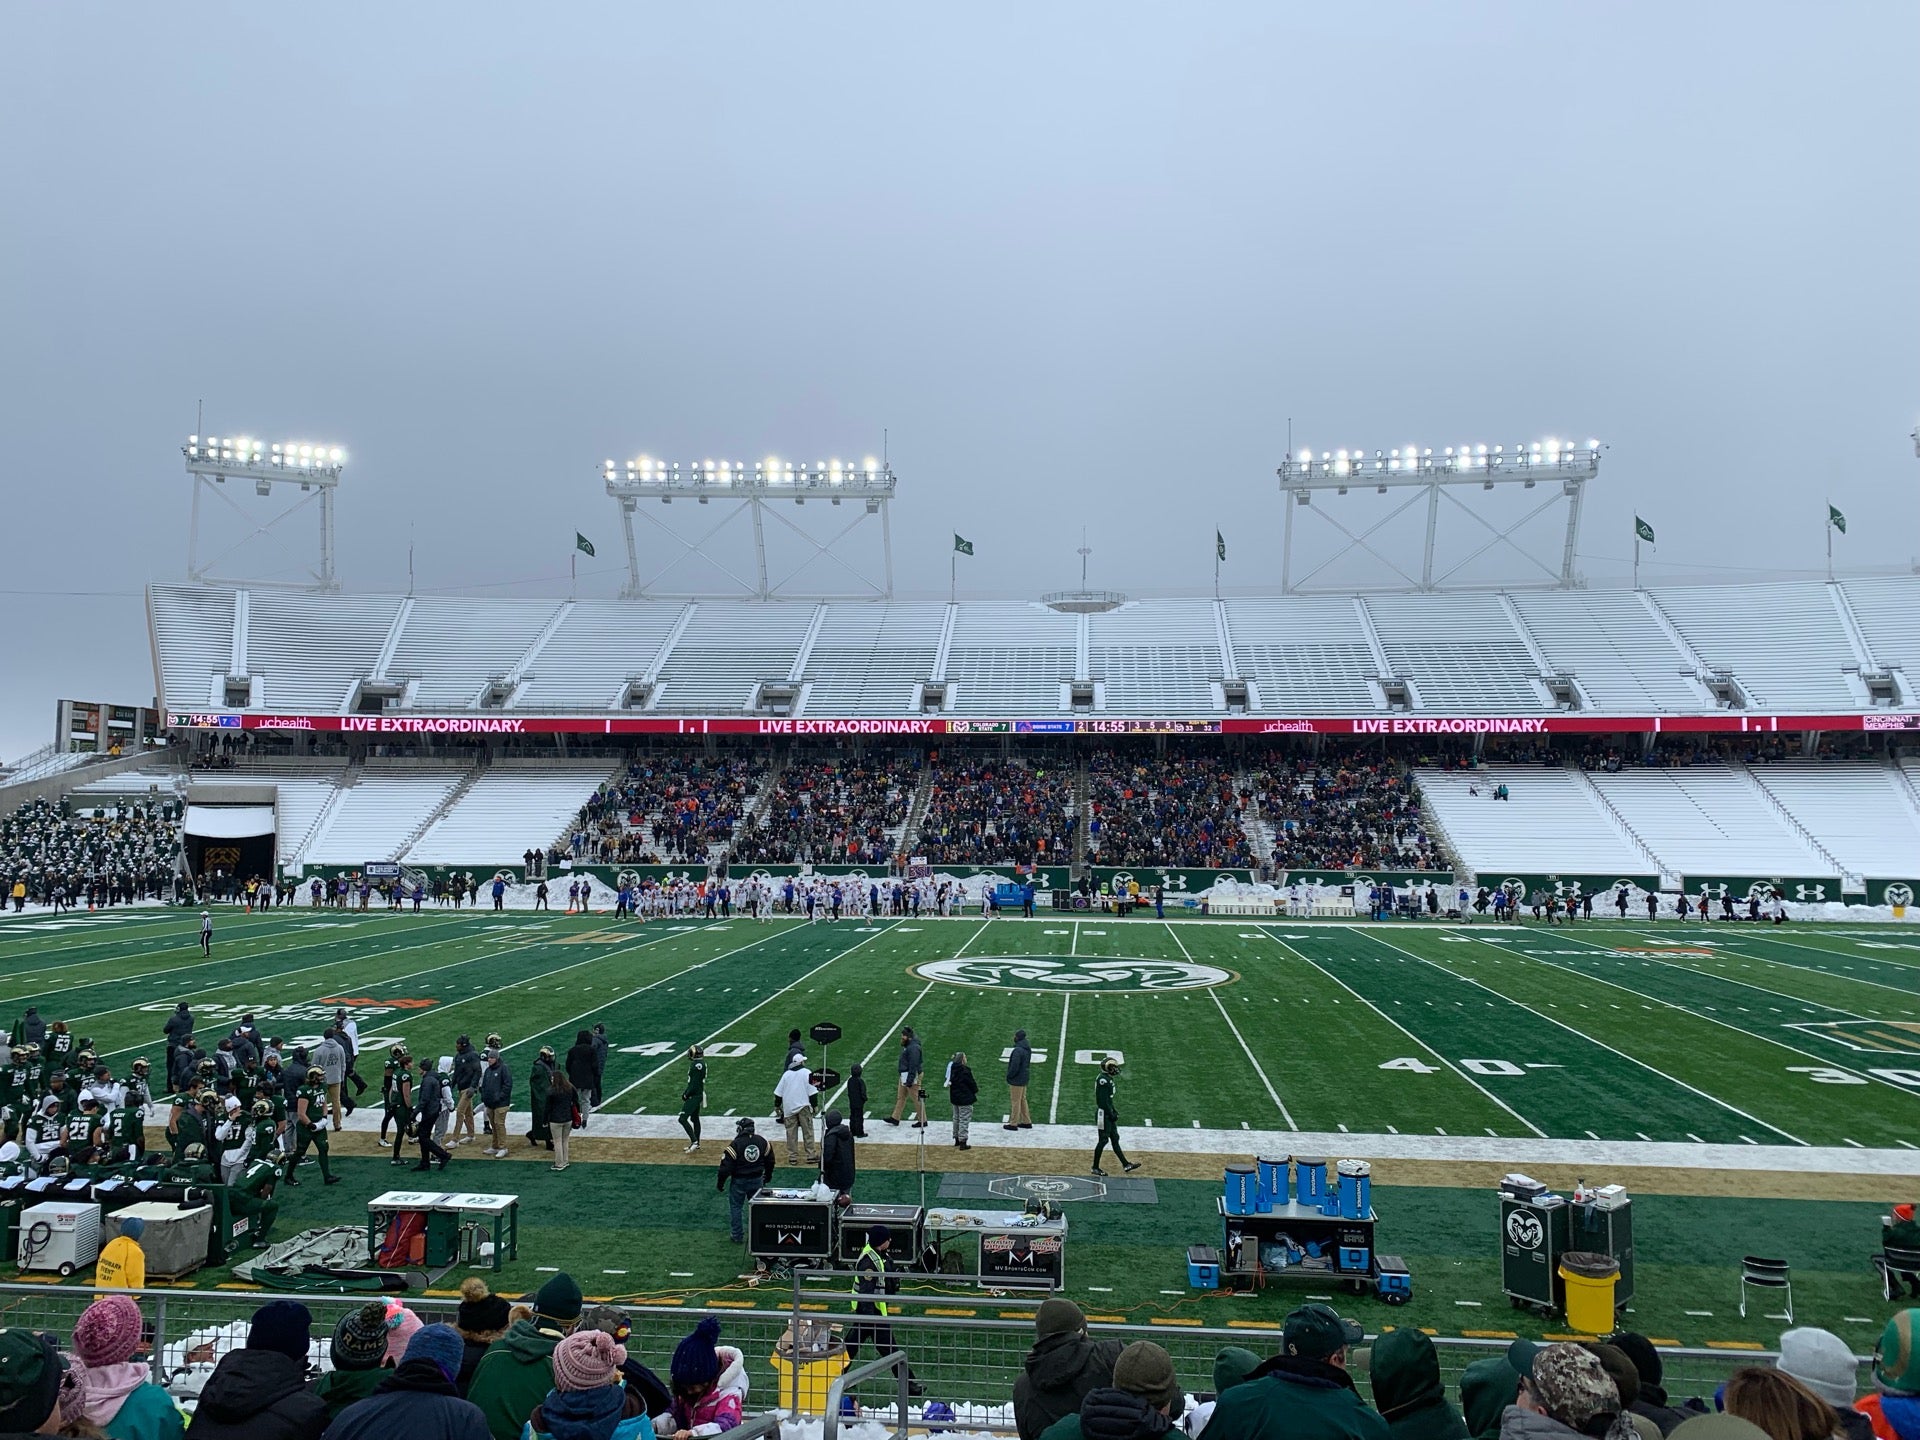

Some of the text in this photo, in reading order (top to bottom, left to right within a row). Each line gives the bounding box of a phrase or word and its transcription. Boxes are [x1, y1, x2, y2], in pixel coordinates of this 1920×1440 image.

[192, 715, 218, 724] 14:55
[259, 716, 312, 729] uchealth
[1078, 721, 1084, 729] 2
[1135, 721, 1140, 729] 3
[1150, 721, 1155, 729] 5
[1165, 721, 1171, 729] 5
[341, 718, 525, 733] LIVE EXTRAORDINARY.
[759, 720, 934, 734] LIVE EXTRAORDINARY.
[1001, 723, 1006, 731] 7
[1065, 723, 1070, 731] 7
[1092, 721, 1125, 732] 14:55
[1264, 719, 1313, 732] uchealth
[1353, 718, 1548, 733] LIVE EXTRAORDINARY.
[54, 1039, 71, 1052] 53
[69, 1121, 89, 1140] 23
[113, 1118, 123, 1137] 2
[983, 1239, 1016, 1247] INTERSTATE
[1029, 1239, 1061, 1247] INTERSTATE
[342, 1333, 385, 1351] RAMS
